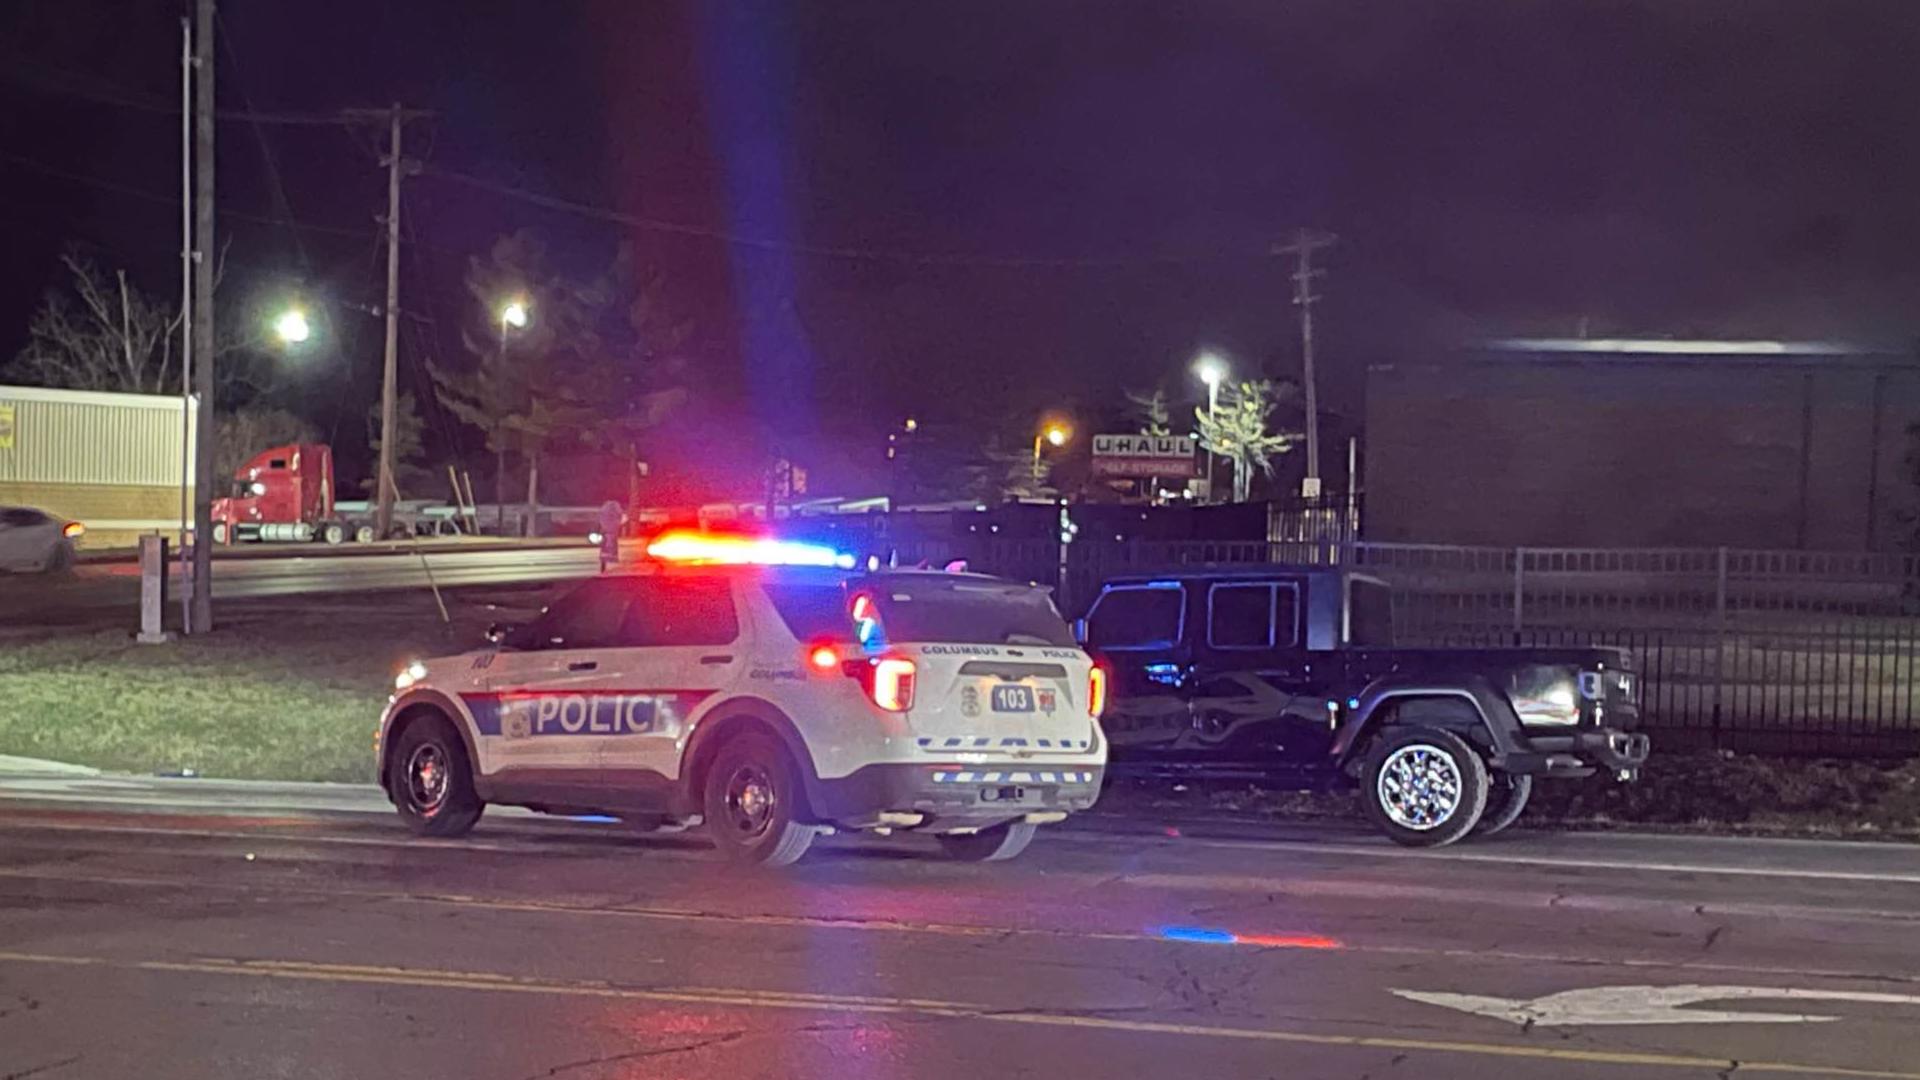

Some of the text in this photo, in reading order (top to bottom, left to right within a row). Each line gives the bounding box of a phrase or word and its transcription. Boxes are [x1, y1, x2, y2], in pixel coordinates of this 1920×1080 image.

[922, 646, 999, 656] COLUMBUS
[999, 688, 1027, 710] 103
[537, 694, 678, 733] POLICE
